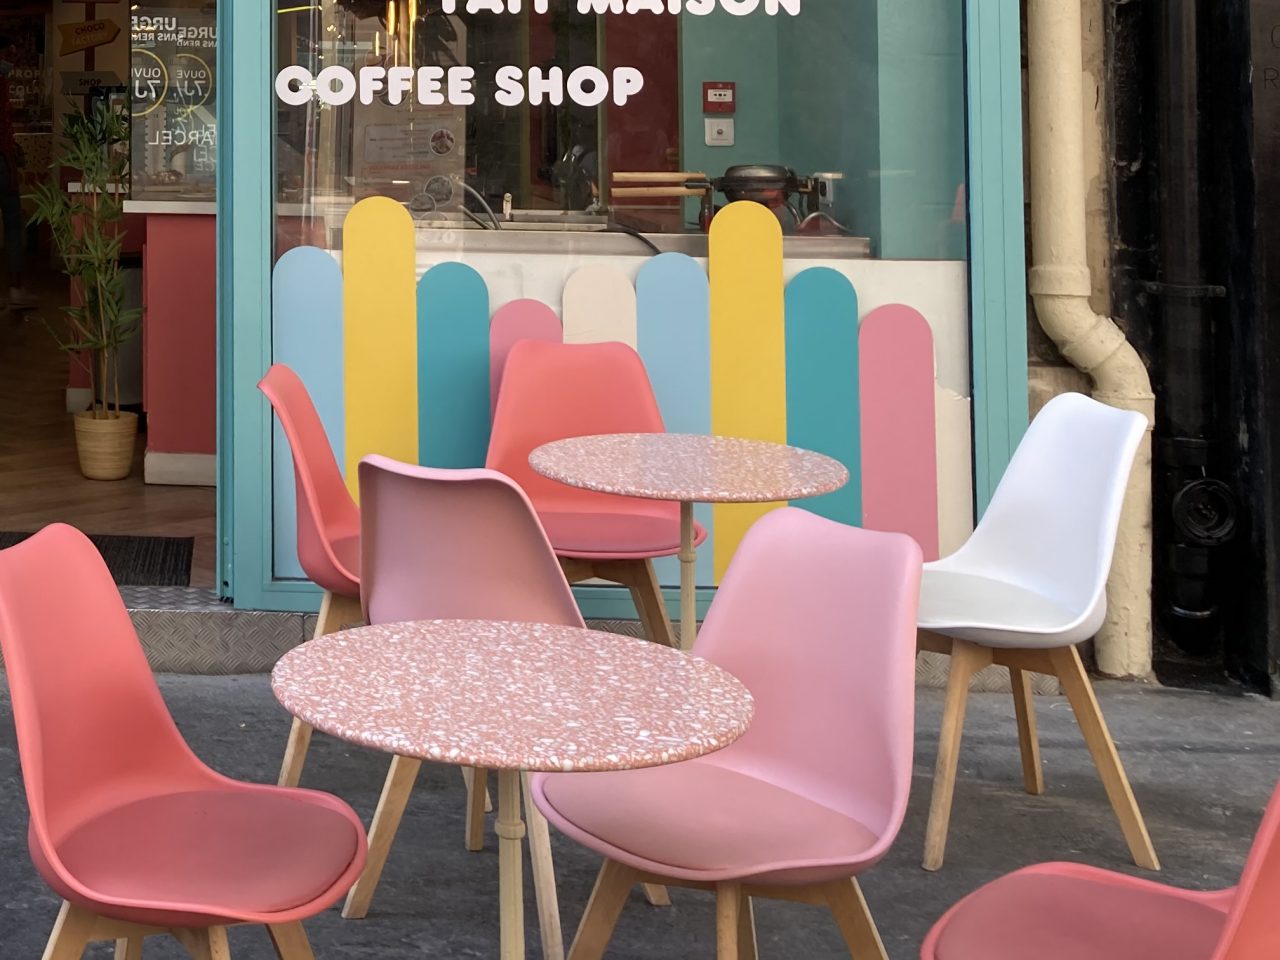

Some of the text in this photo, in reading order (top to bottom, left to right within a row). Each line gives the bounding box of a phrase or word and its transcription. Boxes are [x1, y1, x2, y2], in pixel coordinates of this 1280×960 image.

[75, 22, 105, 35] CHOCO
[79, 78, 102, 88] SHOP
[275, 65, 645, 107] COFFEE SHOP
